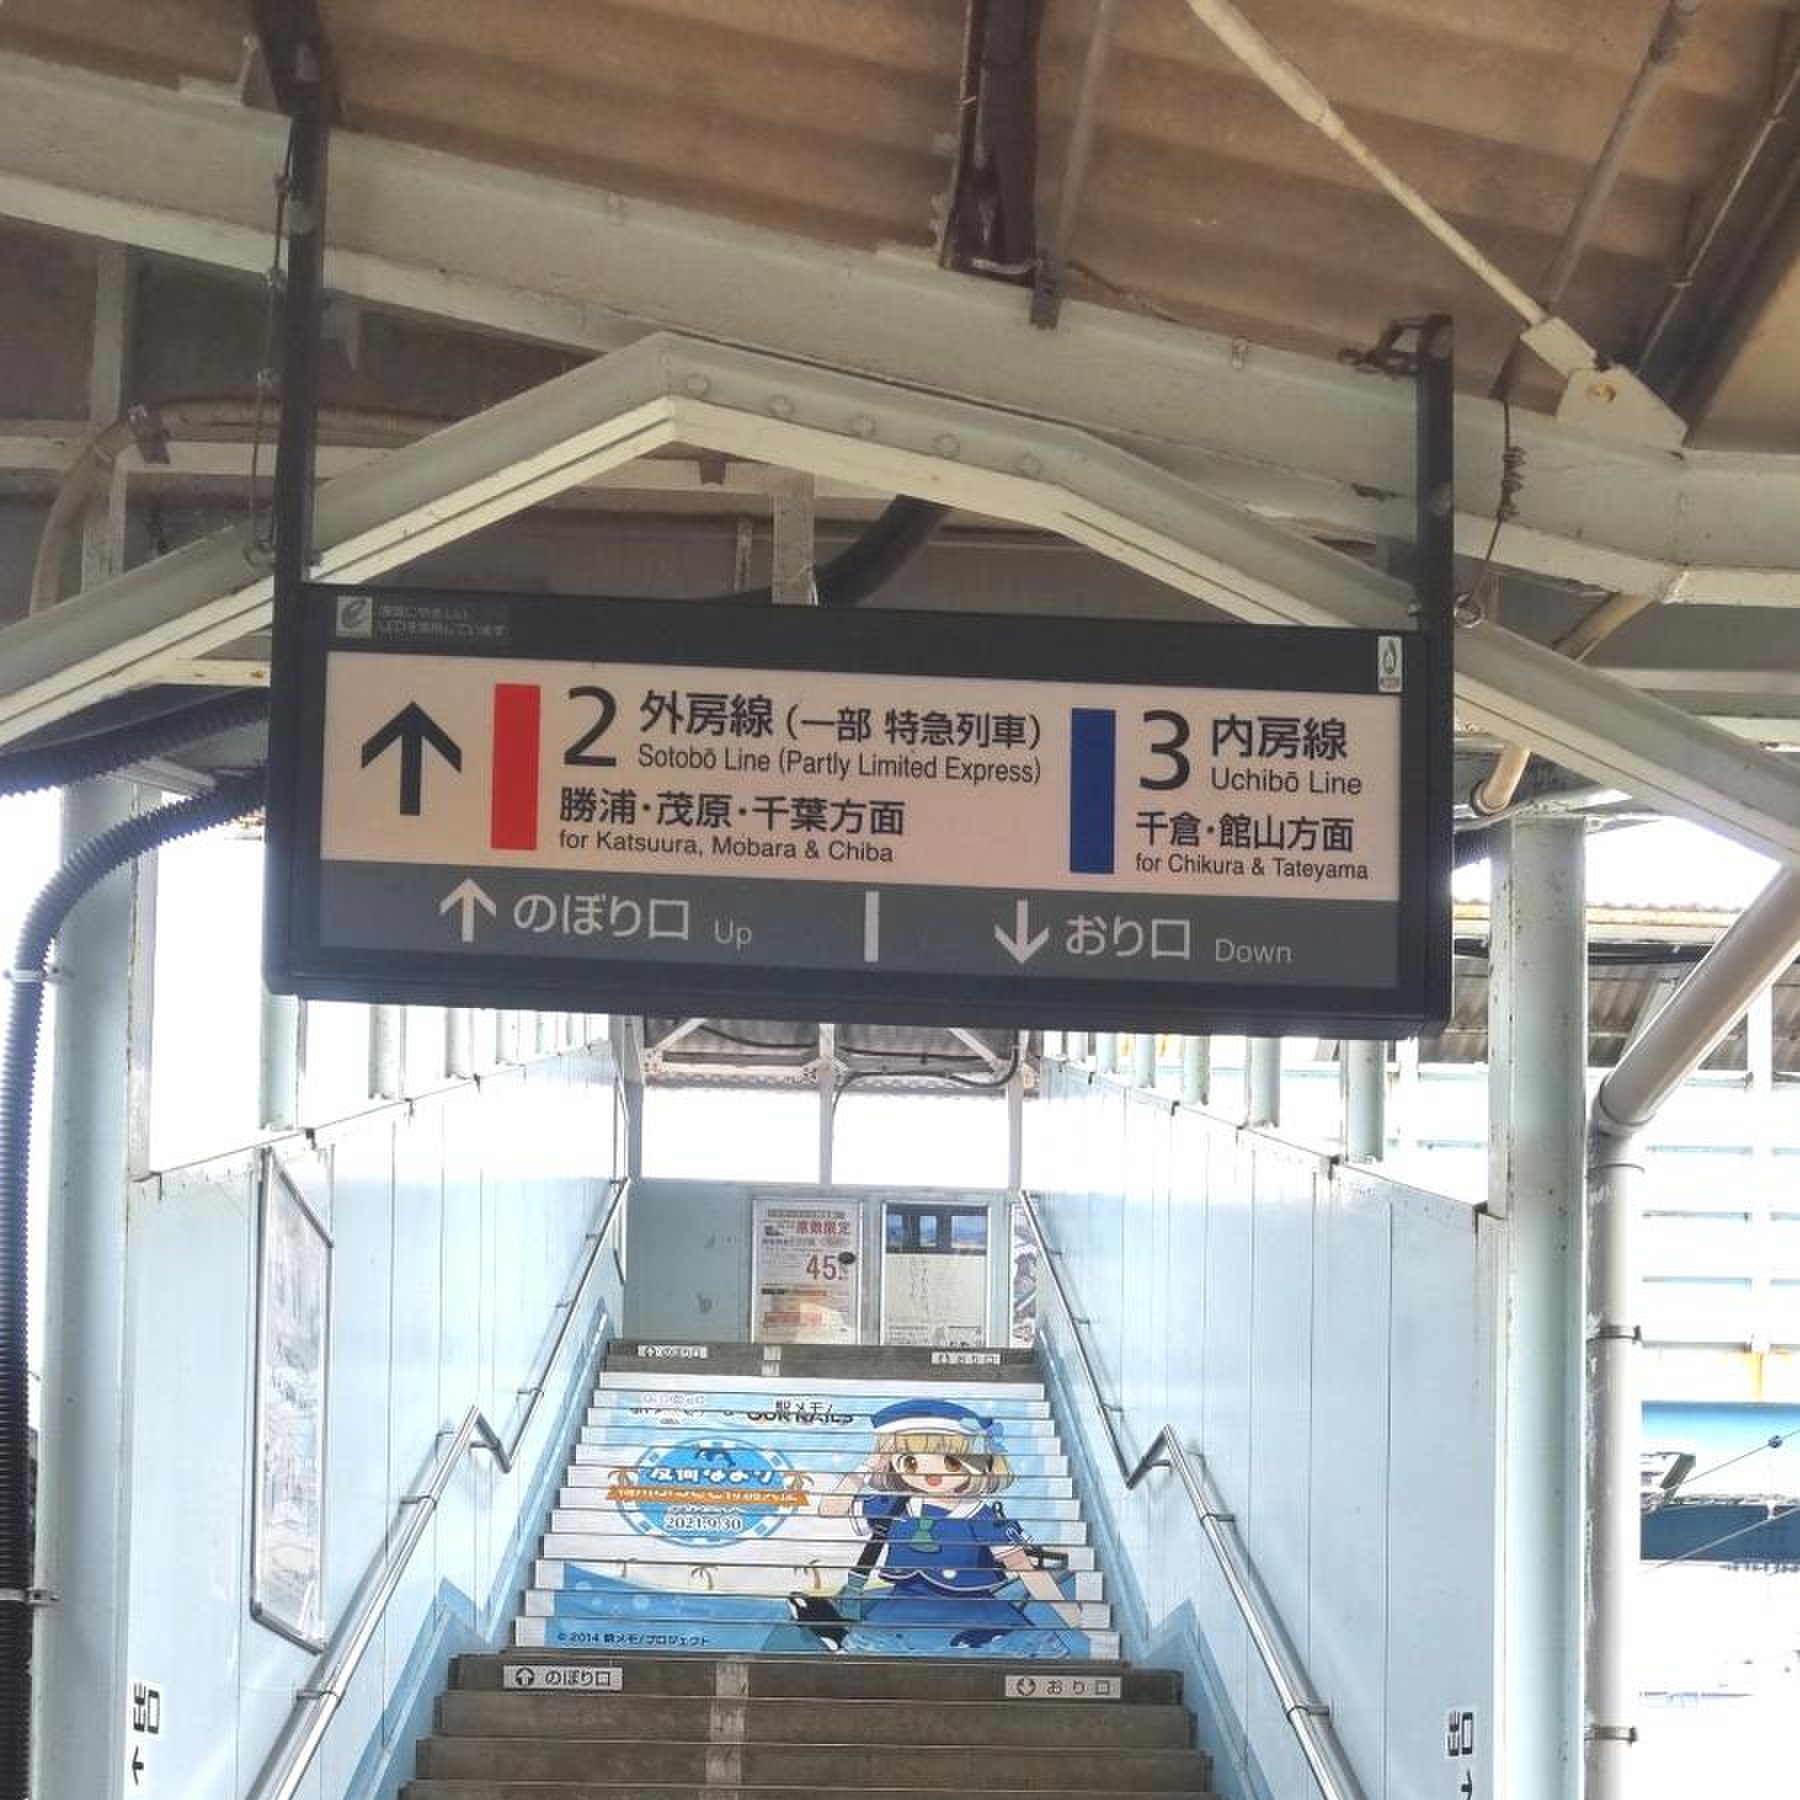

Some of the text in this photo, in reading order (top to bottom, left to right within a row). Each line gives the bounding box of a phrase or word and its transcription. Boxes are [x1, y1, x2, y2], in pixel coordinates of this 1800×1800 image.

[564, 685, 617, 768] 2
[639, 690, 773, 739] 外房線
[885, 708, 1041, 751] 特急列車)
[638, 742, 1042, 786] Sotobō Line (Partly Limited Express)
[1139, 709, 1348, 791] 3 内房線
[1211, 767, 1363, 796] Uchibō Line
[560, 786, 906, 836] 勝浦・茂原・千葉方面
[1135, 810, 1354, 853] 千倉・館山方面
[559, 829, 894, 863] for Katsuura, Mobara & Chiba
[1135, 852, 1370, 885] for Chikura & Tateyama
[513, 892, 753, 951] のぼり口 Up
[1065, 913, 1293, 965] おり口 Down
[545, 1670, 611, 1686] のぼり口
[1046, 1679, 1111, 1697] おり口
